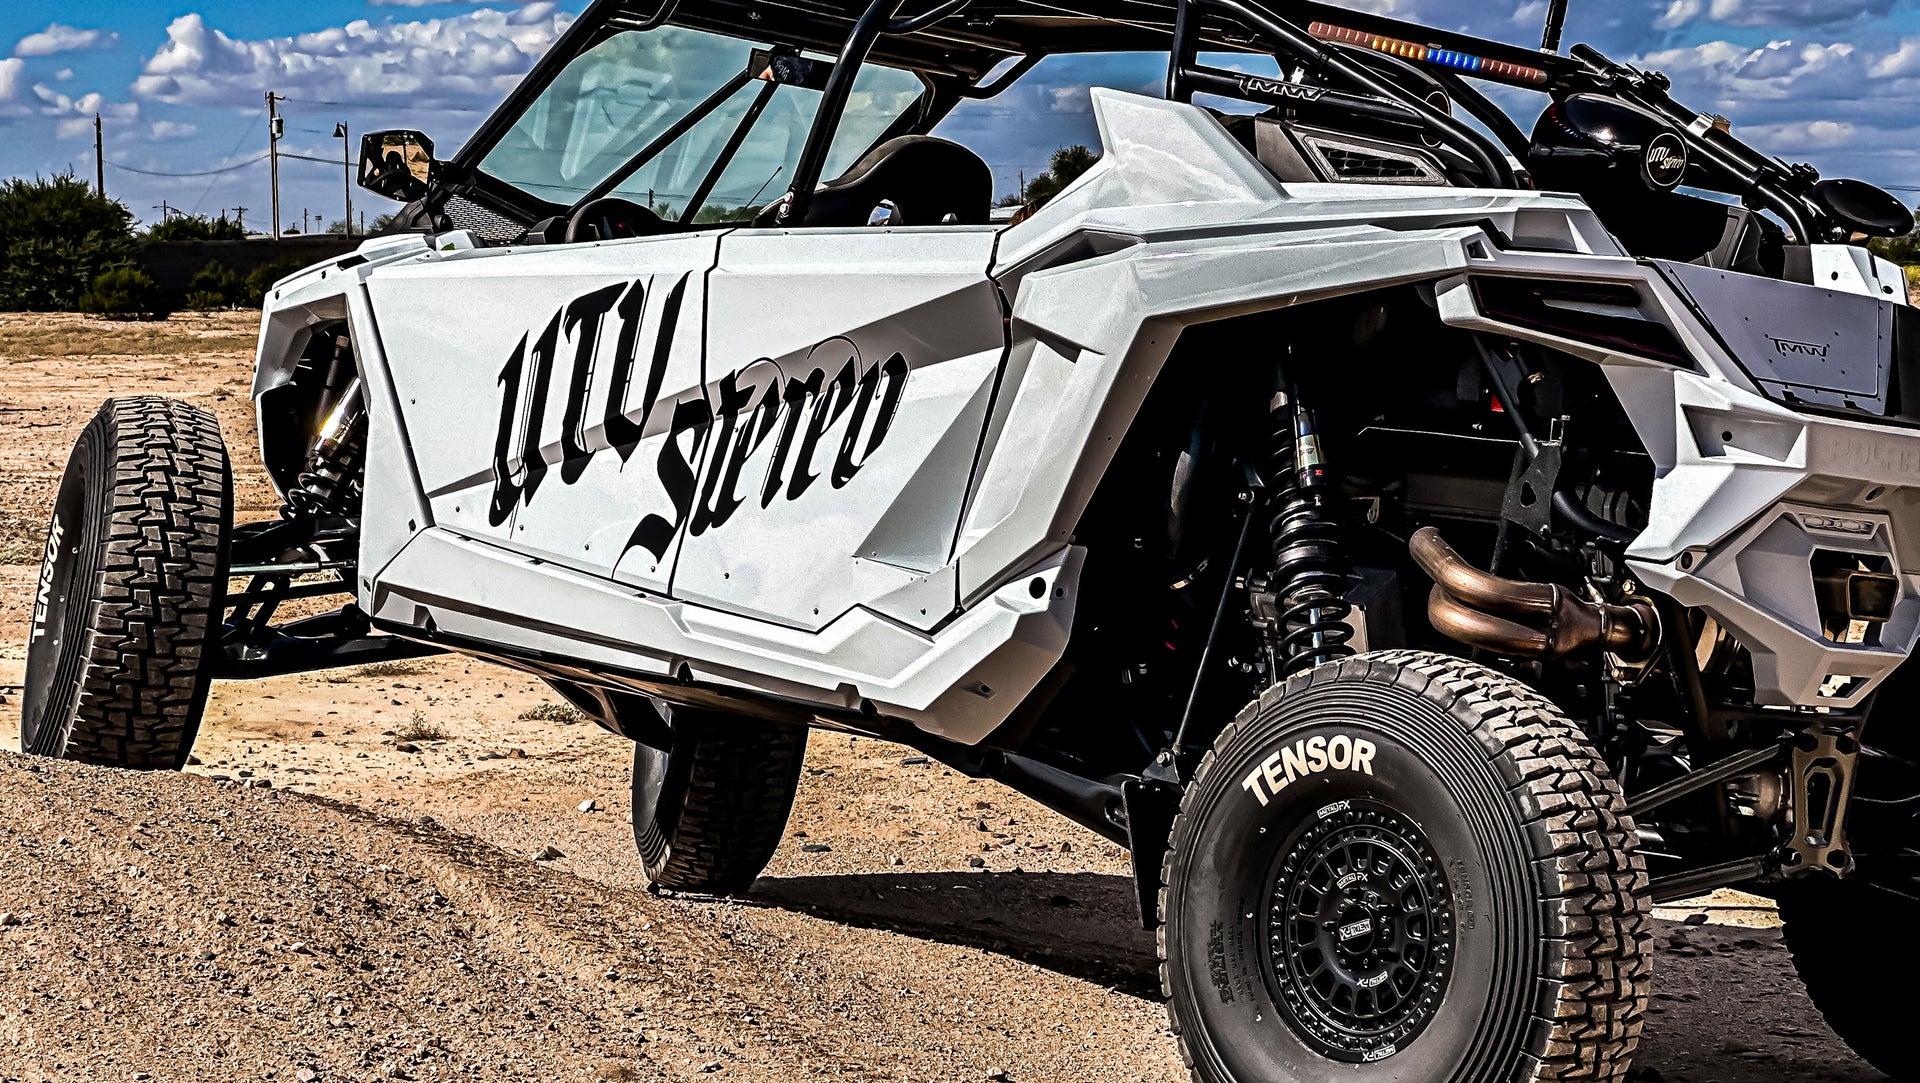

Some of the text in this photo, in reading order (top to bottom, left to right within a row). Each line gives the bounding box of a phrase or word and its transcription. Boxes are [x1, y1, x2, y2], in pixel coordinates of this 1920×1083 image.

[1768, 336, 1827, 358] TMW
[489, 270, 694, 539] UTV
[32, 513, 65, 643] TENSOR
[1241, 734, 1377, 807] TENSOR
[1338, 800, 1351, 811] FX
[1356, 872, 1368, 882] FX
